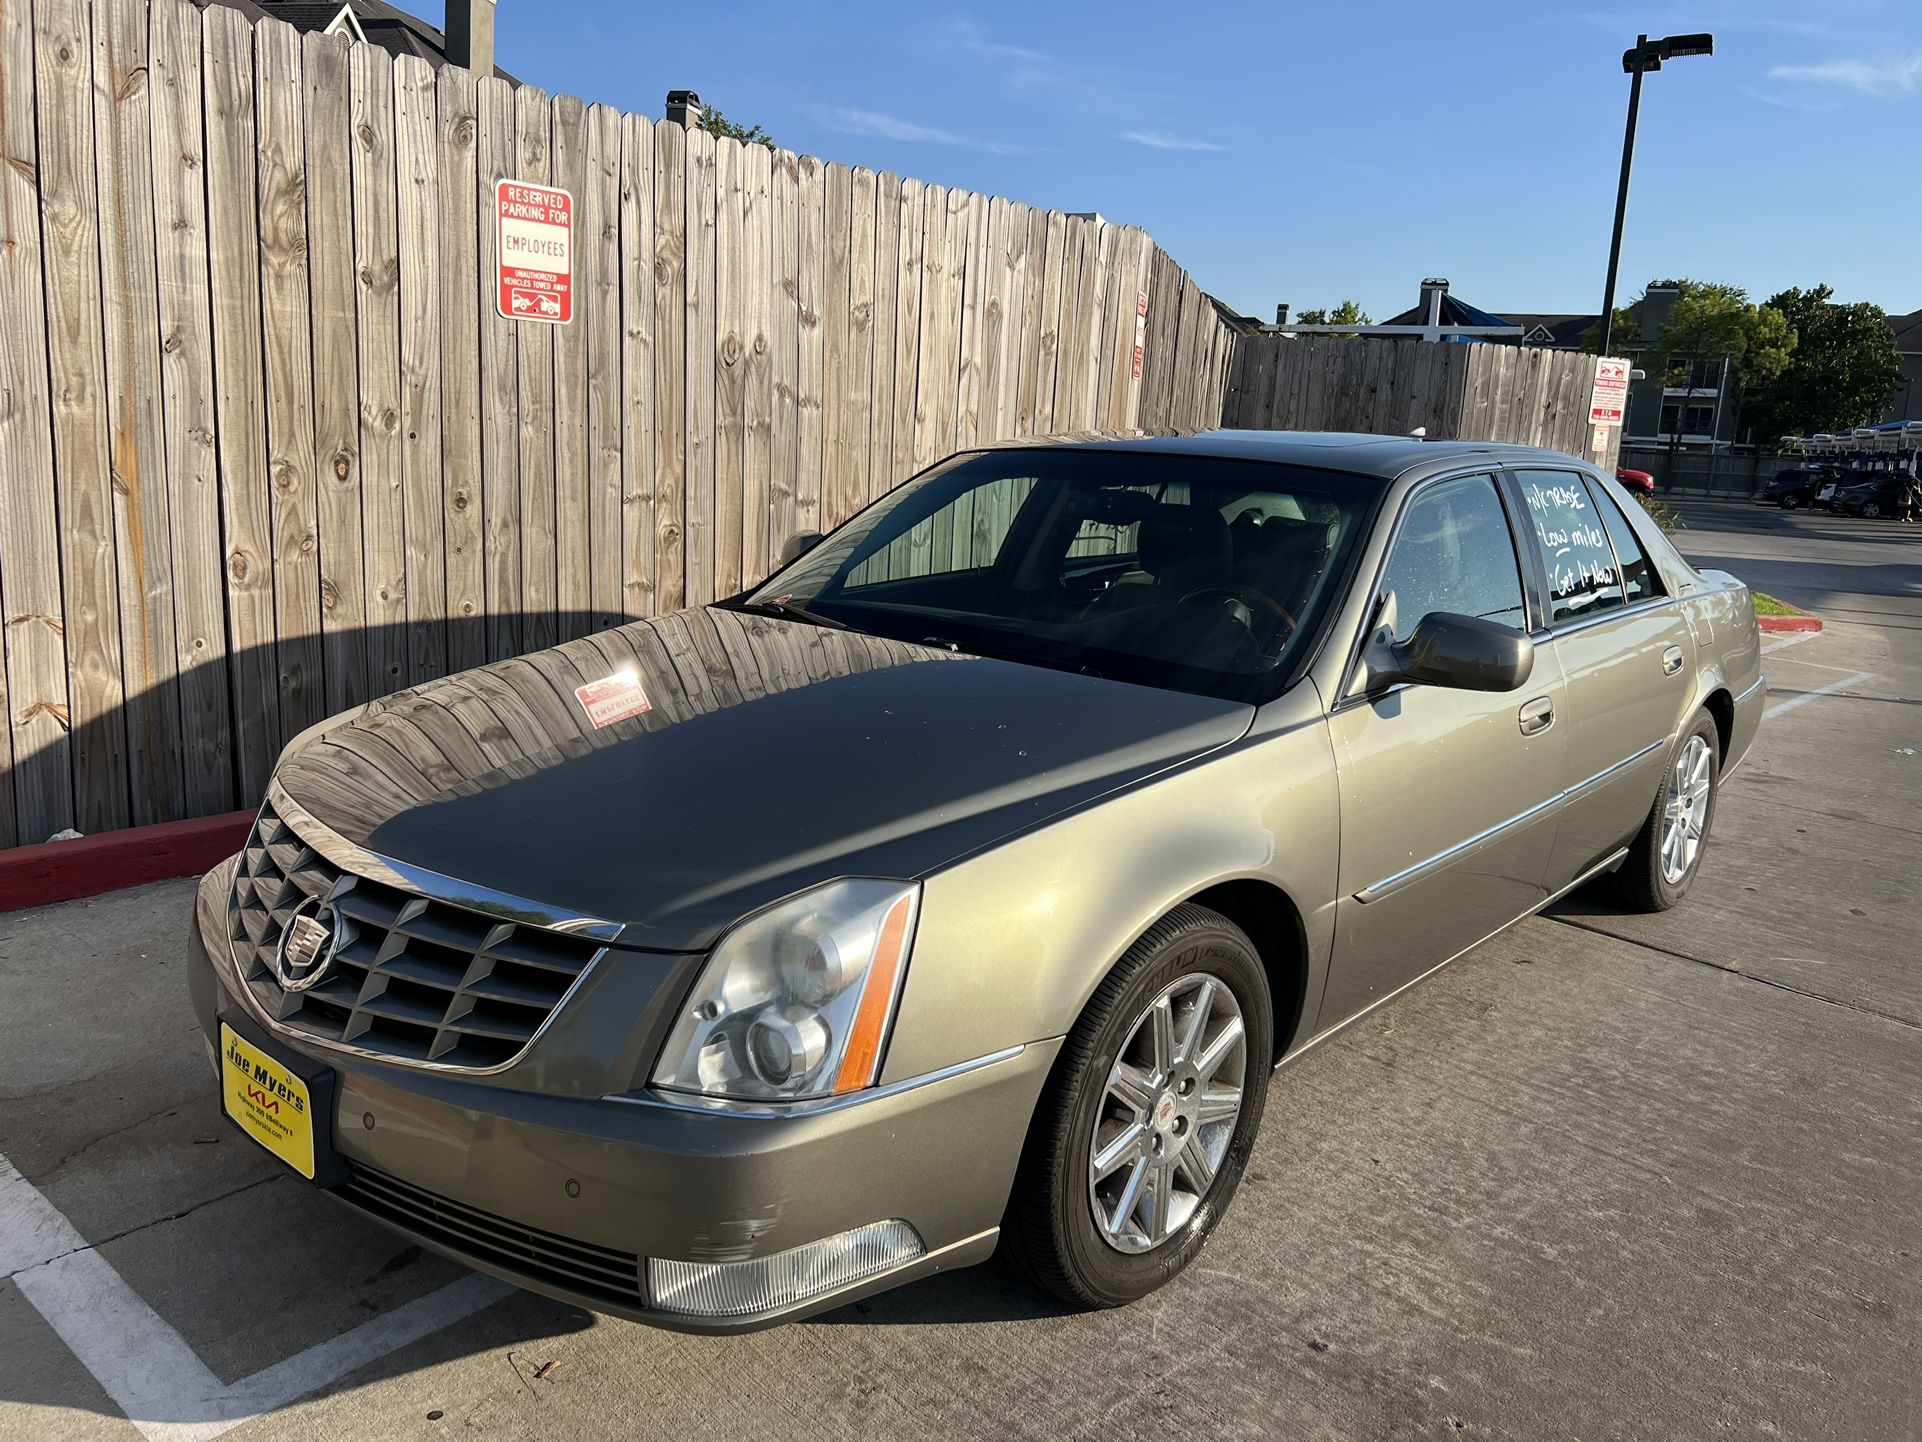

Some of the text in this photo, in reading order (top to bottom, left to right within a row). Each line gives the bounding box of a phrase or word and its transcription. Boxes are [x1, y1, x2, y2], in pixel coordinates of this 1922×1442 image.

[508, 187, 564, 209] RESERVED
[501, 201, 568, 225] PARKING FOR
[506, 235, 565, 258] EMPLOYEES
[503, 277, 568, 292] VEHICLES TOWED AWAY
[514, 269, 557, 282] UNAUTHORIZED
[1571, 524, 1603, 548] miles
[1555, 564, 1575, 596] Get
[1591, 560, 1612, 585] Now
[227, 1045, 304, 1112] Joe Myers
